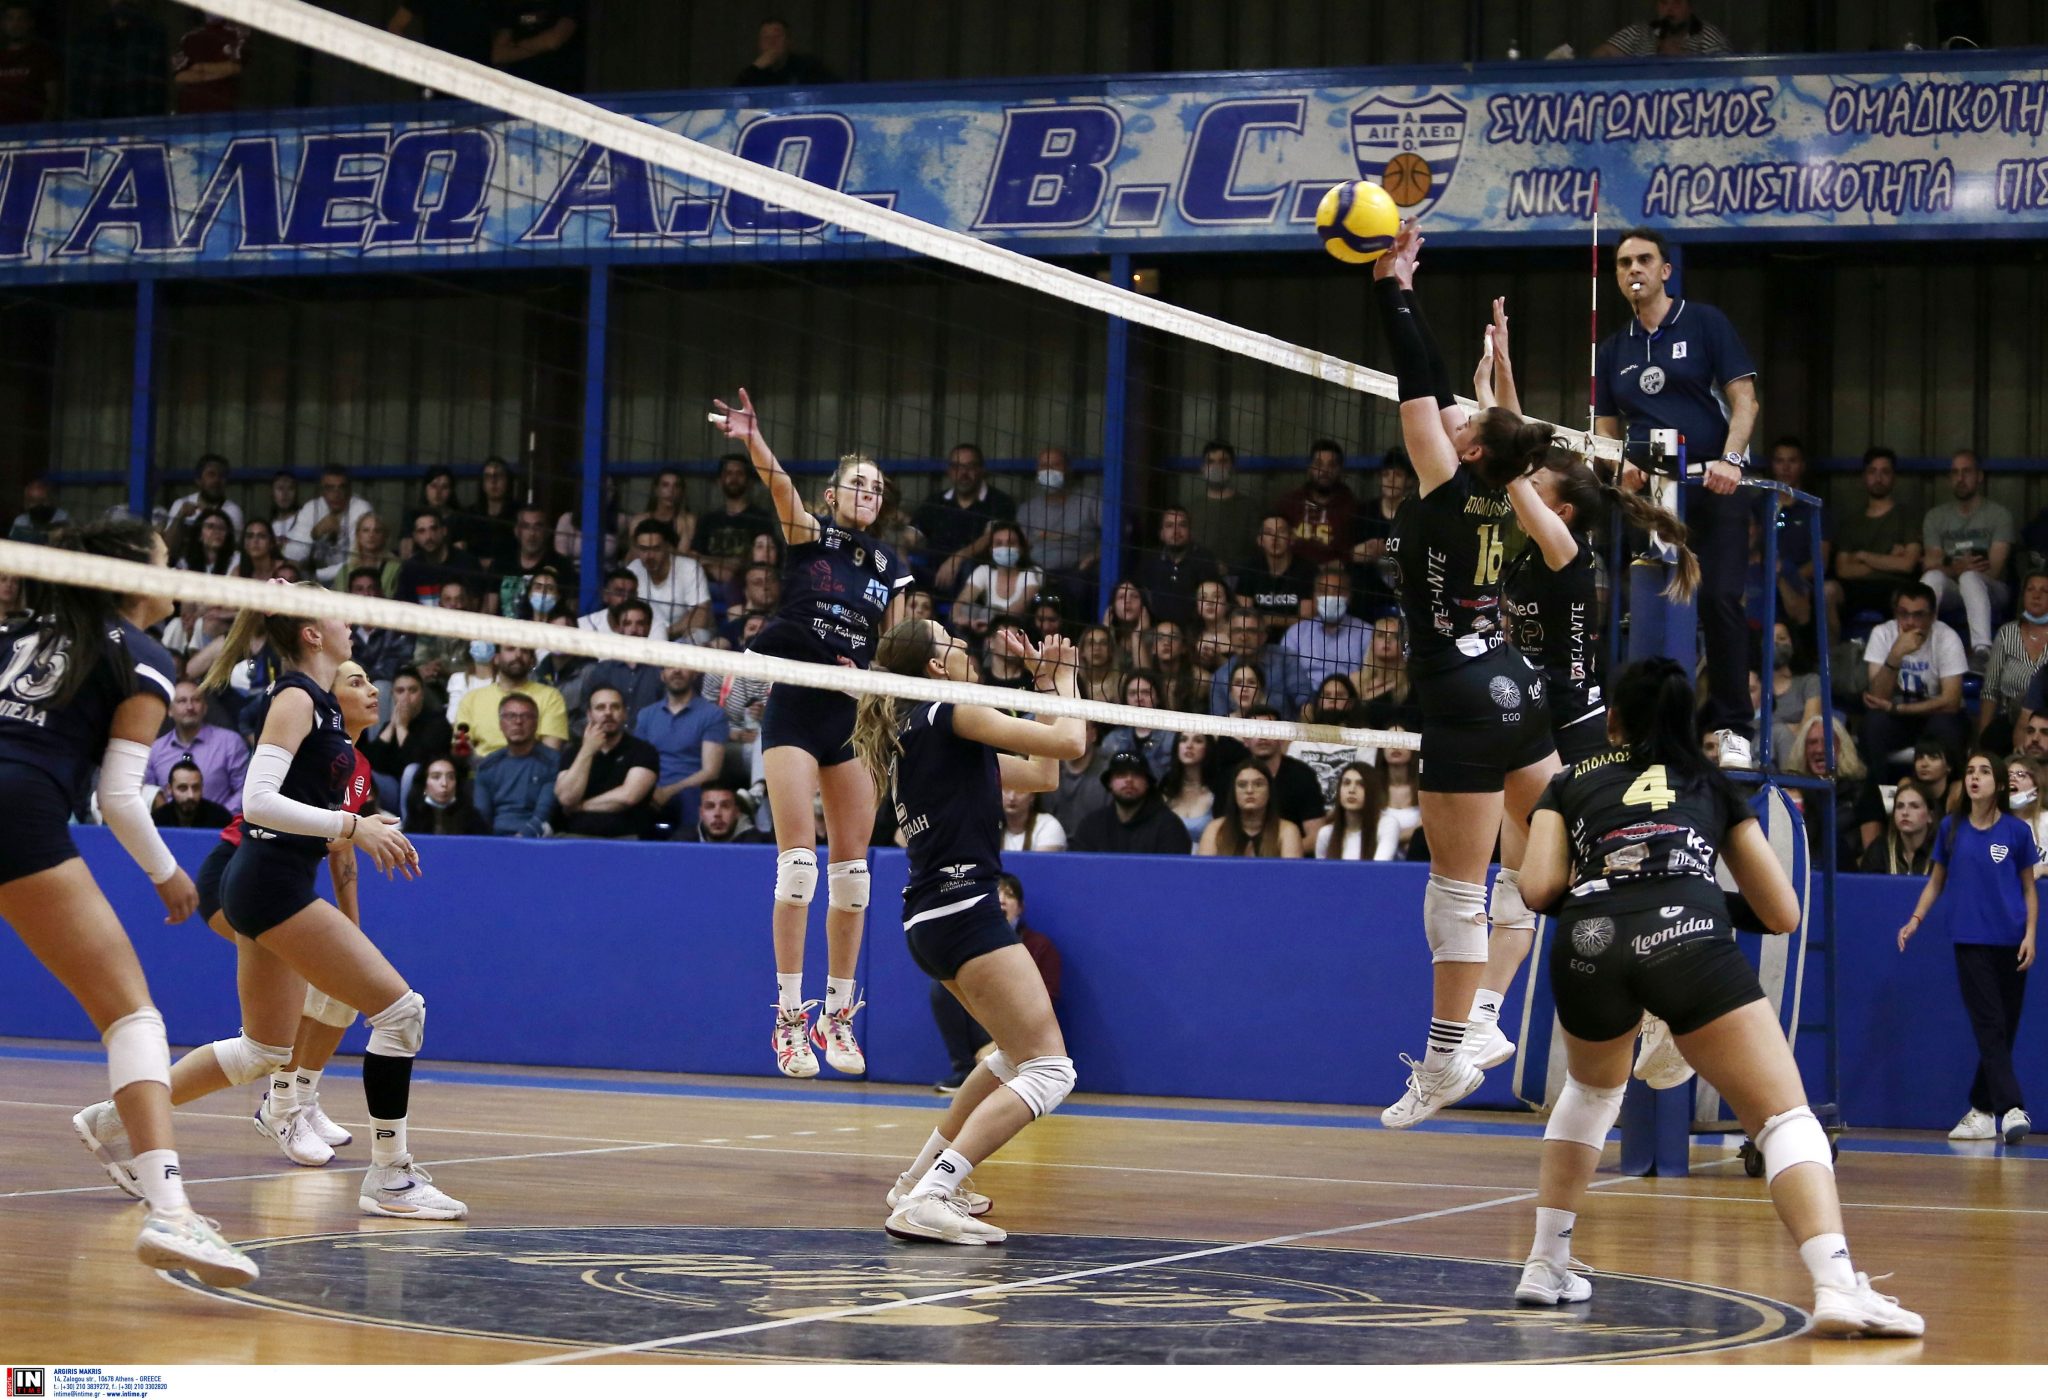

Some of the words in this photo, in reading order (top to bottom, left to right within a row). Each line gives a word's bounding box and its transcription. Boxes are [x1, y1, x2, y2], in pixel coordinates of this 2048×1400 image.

[1368, 125, 1456, 139] ΑΙΓΑΛΕΩ
[1487, 85, 1775, 144] ΣΥΝΑΓΩΝΙΣΜΟΣ
[1507, 166, 1598, 221] ΝΙΚΗ
[1643, 156, 1953, 222] ΑΓΩΝΙΣΤΙΚΟΤΗΤΑ
[853, 547, 866, 567] 9
[1473, 524, 1503, 586] 16
[1502, 712, 1521, 722] EGO
[1622, 764, 1676, 813] 4
[1631, 917, 1714, 955] Leonidas
[1570, 958, 1596, 974] EGO
